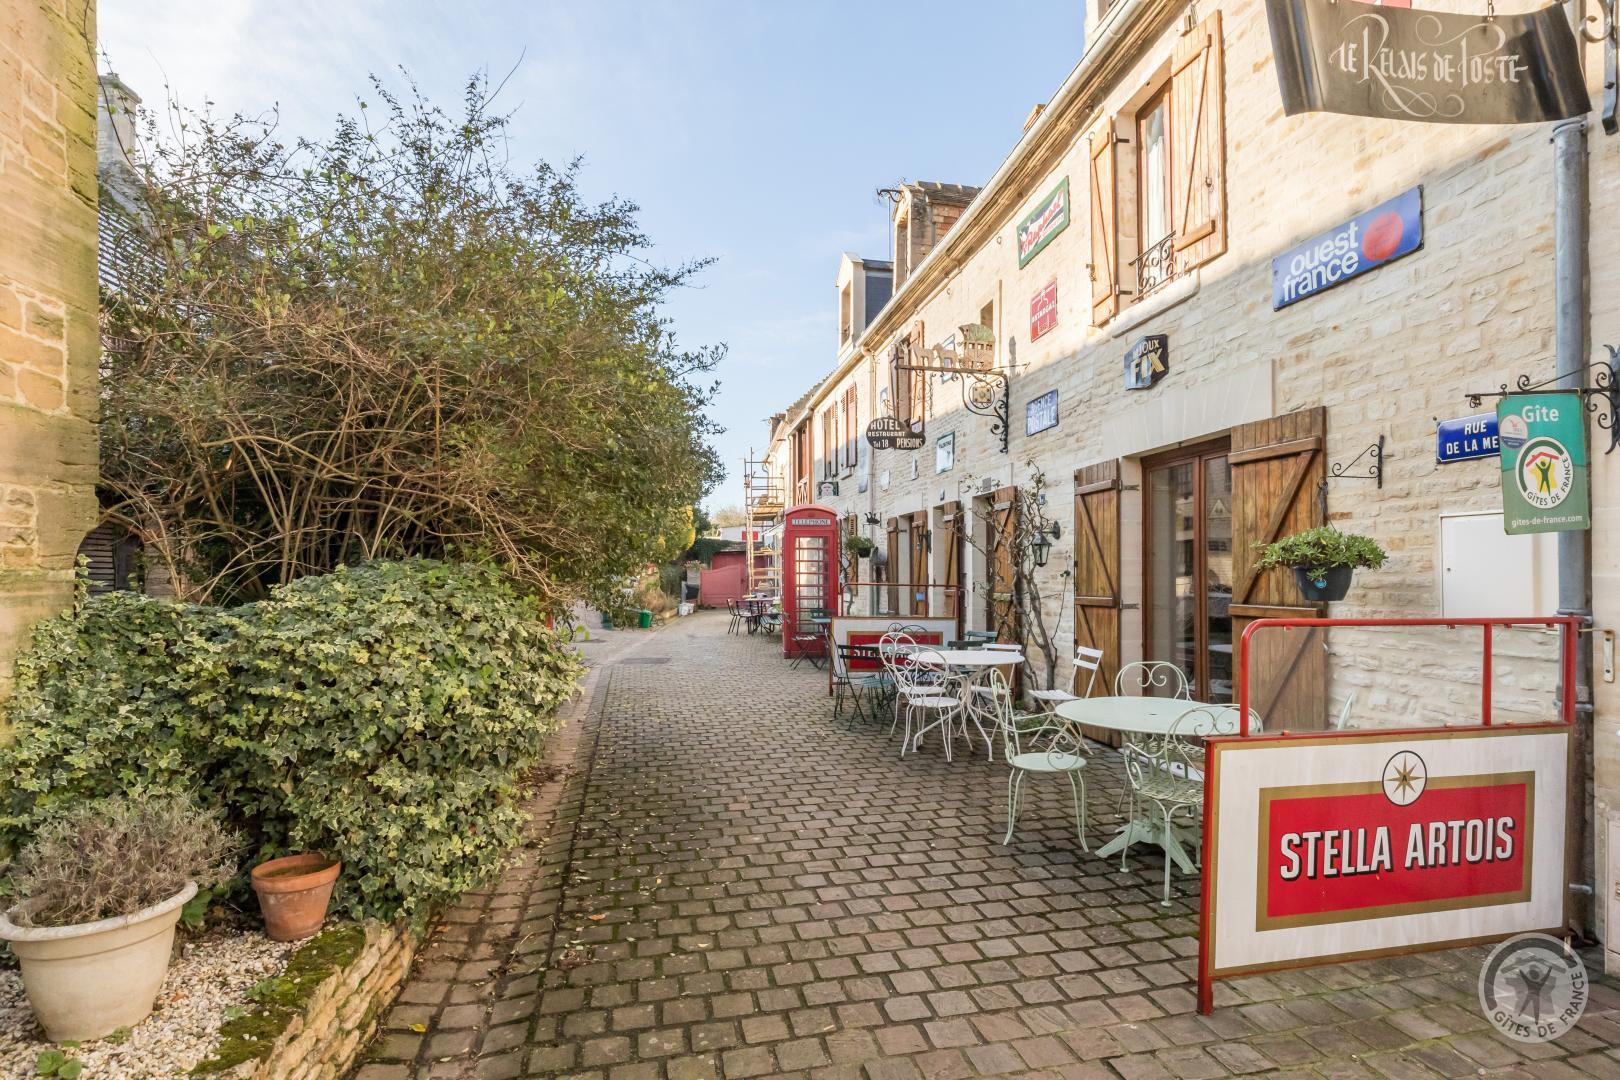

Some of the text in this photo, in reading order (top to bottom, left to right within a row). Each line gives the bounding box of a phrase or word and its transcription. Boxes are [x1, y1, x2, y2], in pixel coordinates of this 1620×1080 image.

[1289, 220, 1359, 276] ouest
[1282, 250, 1359, 302] france
[1521, 405, 1560, 422] Gîte
[870, 418, 901, 431] HOTEL
[1464, 419, 1488, 436] RUE
[881, 439, 889, 448] 18
[896, 437, 923, 449] PENSIONS
[1446, 441, 1460, 455] DE
[1464, 438, 1479, 453] LA
[1526, 456, 1574, 506] GÎTES DE FRANCE
[1511, 514, 1584, 528] gites-de-france.com
[1279, 815, 1515, 881] STELLA ARTOIS
